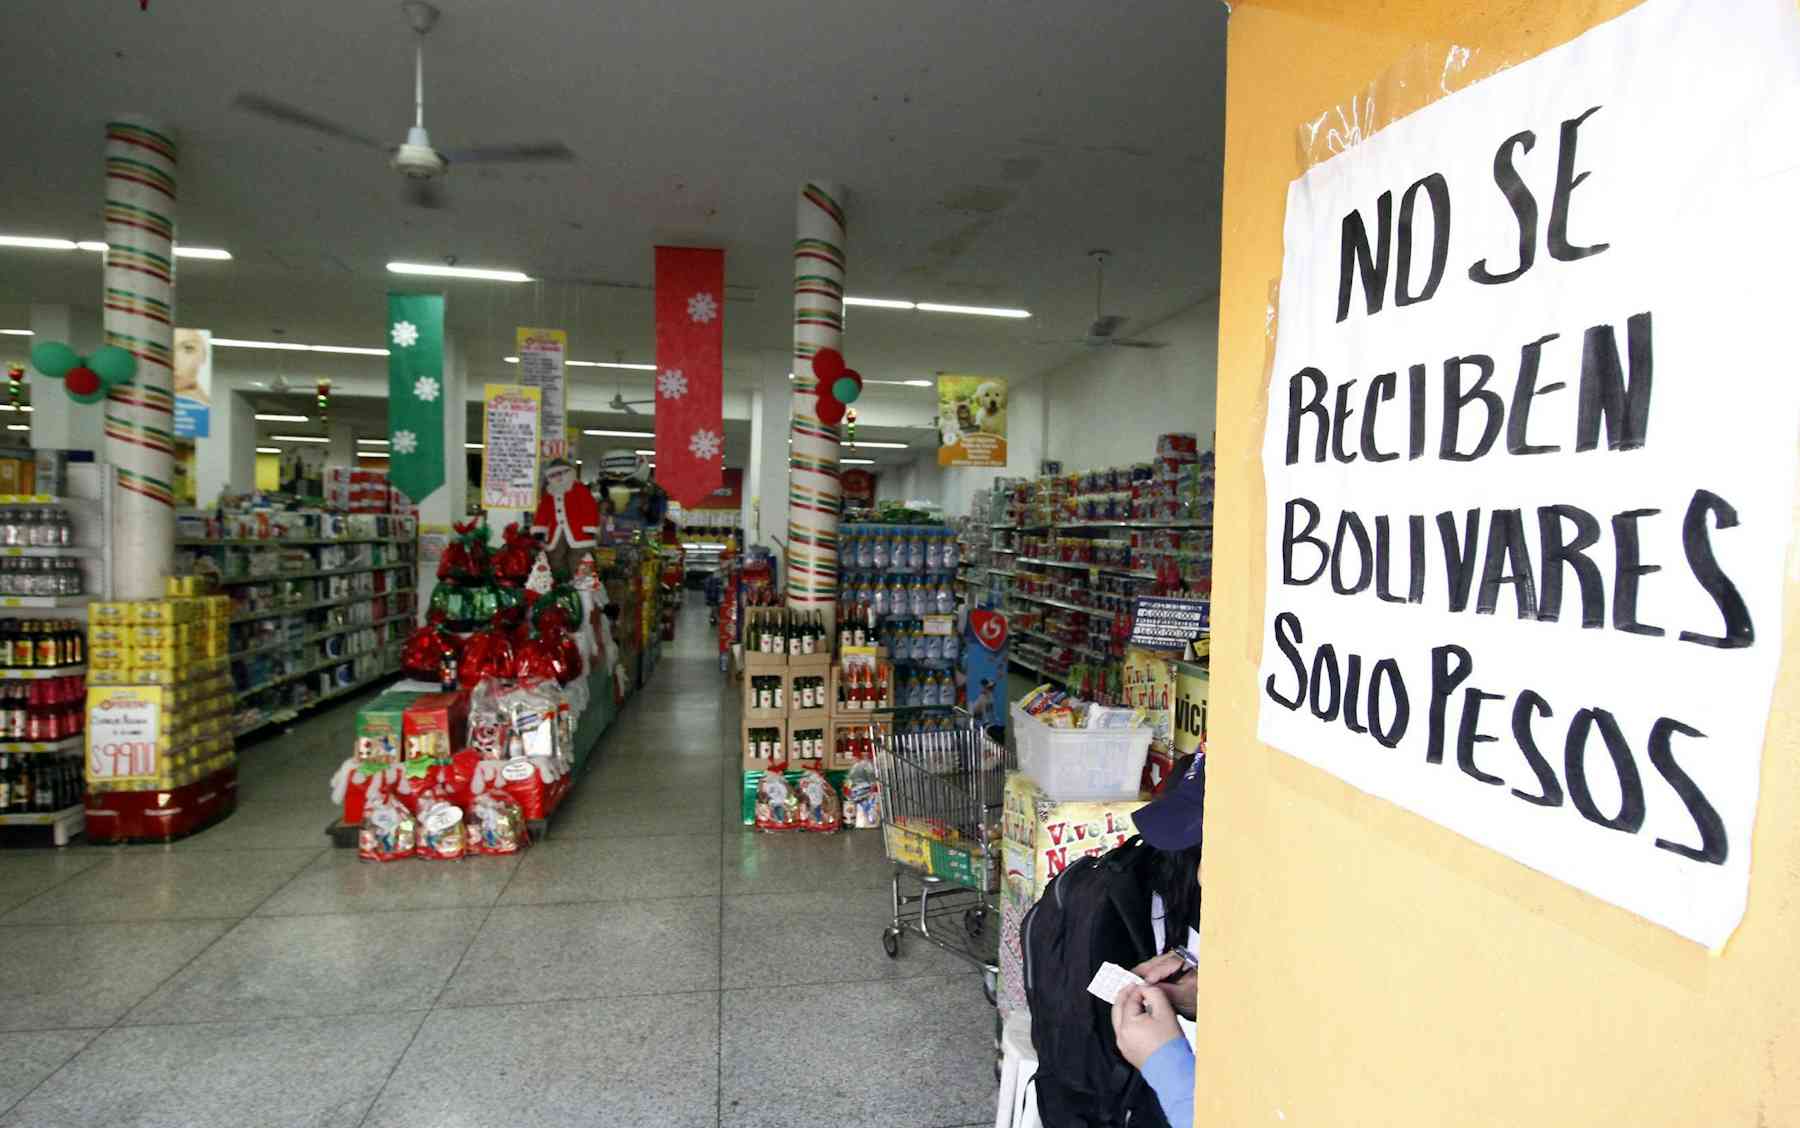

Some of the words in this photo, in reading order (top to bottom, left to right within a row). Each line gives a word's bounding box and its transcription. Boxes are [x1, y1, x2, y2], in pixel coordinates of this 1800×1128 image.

[1335, 172, 1451, 324] NO
[1468, 105, 1610, 285] SE
[1285, 310, 1652, 466] RECIBEN
[1282, 488, 1755, 650] BOLIVARES
[1265, 611, 1411, 749] SOLO
[1426, 643, 1729, 867] PESOS
[1047, 821, 1101, 846] Vive
